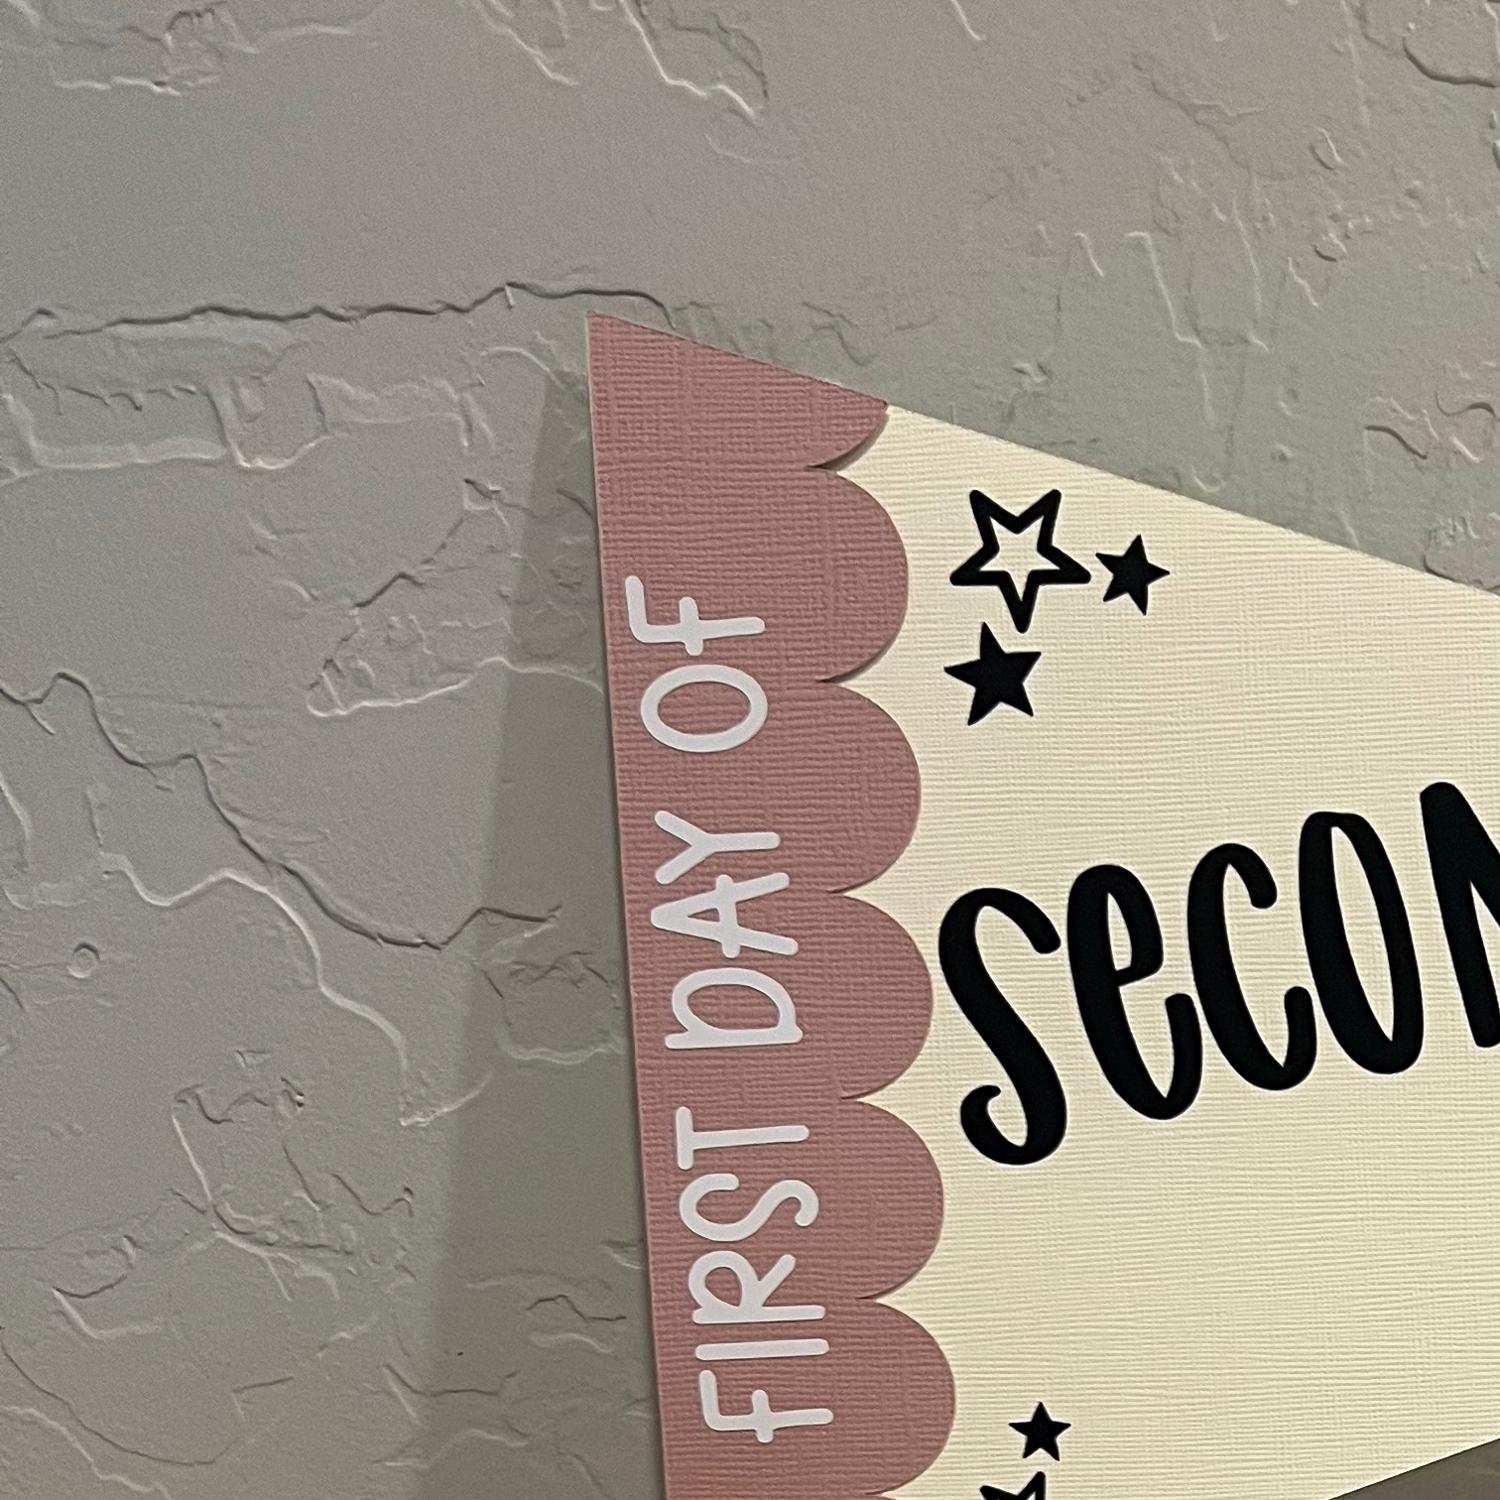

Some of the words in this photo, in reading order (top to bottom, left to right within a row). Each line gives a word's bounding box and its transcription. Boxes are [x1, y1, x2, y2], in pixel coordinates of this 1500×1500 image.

[624, 575, 769, 753] OF
[650, 810, 804, 1049] DAY
[676, 1105, 834, 1444] FIRST
